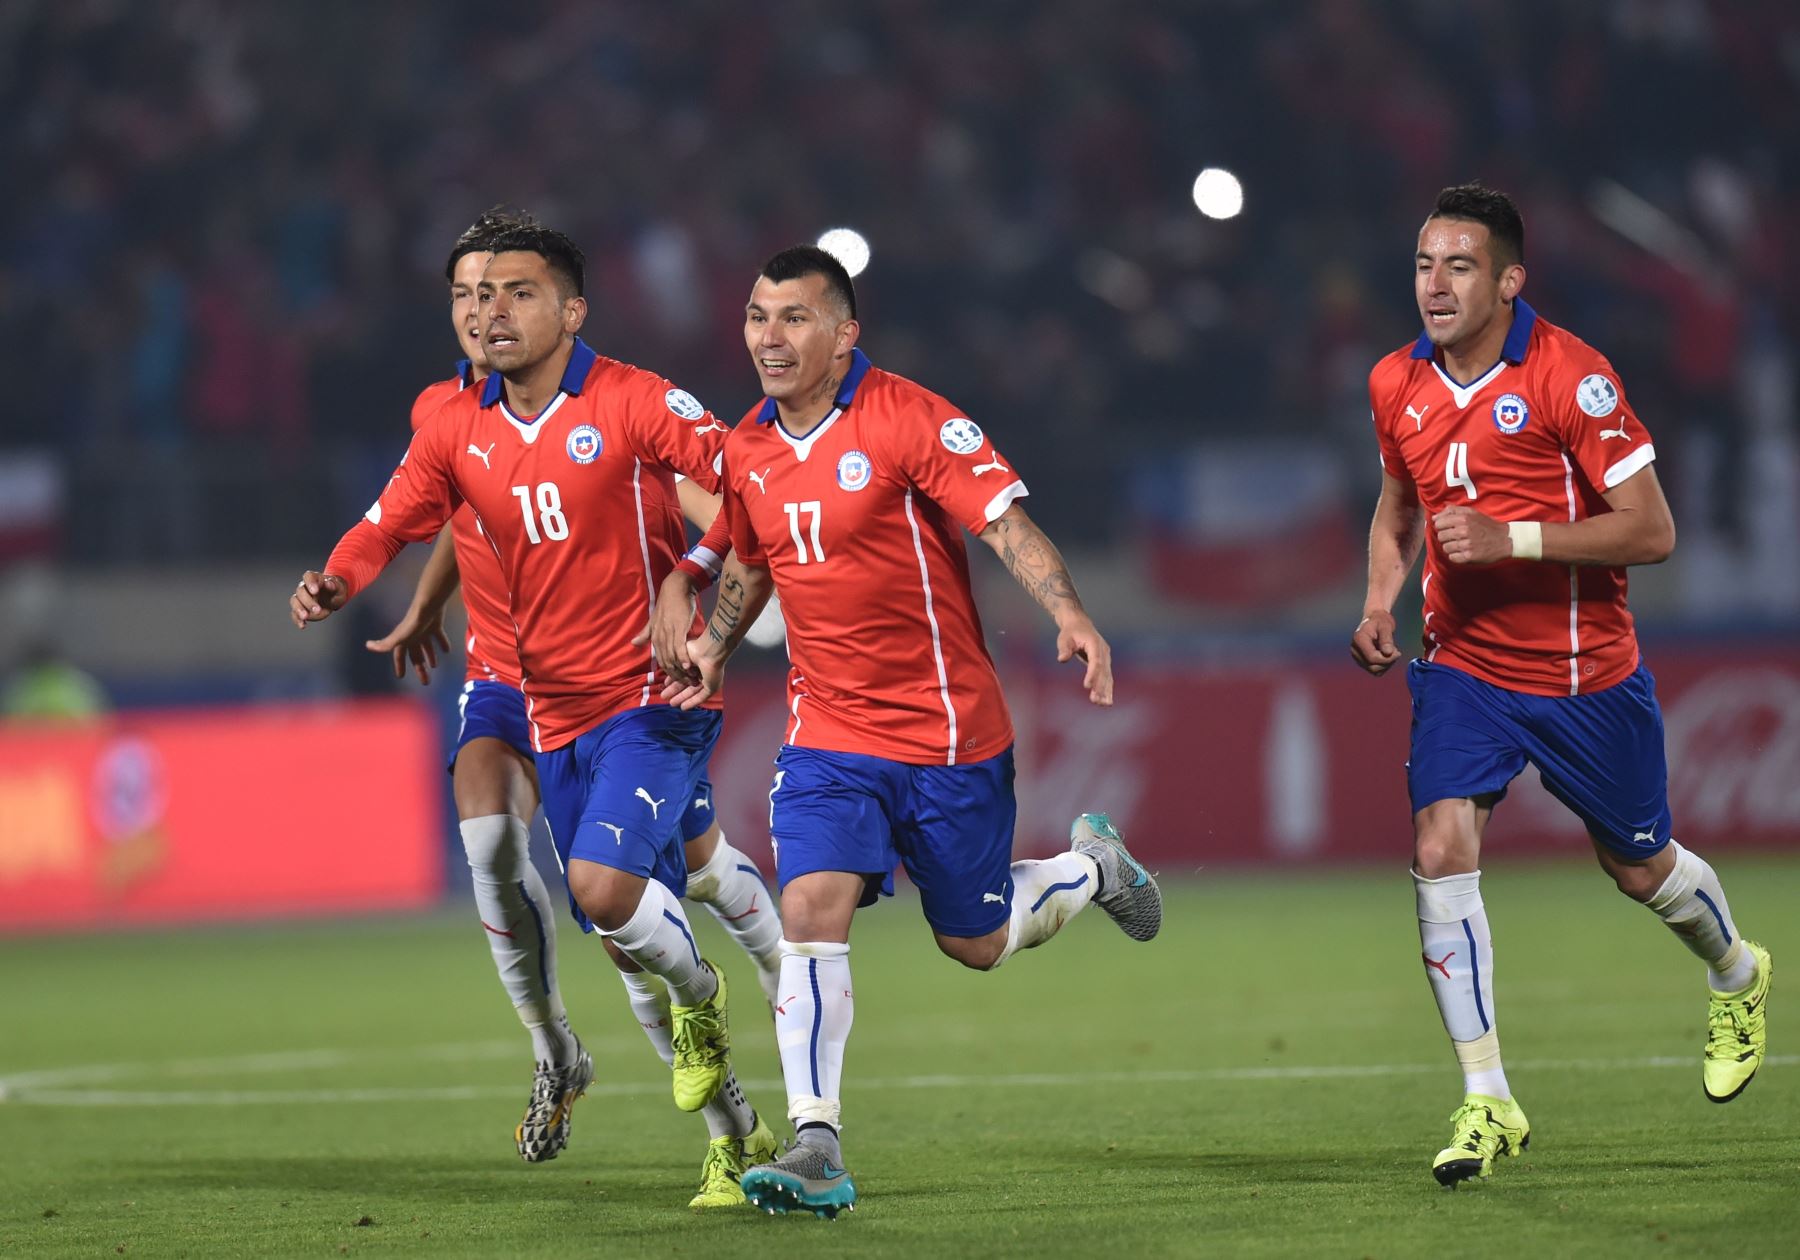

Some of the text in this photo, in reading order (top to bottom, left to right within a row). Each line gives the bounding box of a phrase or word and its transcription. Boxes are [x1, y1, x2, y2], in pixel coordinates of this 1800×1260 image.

[1446, 442, 1477, 500] 4
[511, 481, 569, 544] 18
[783, 500, 826, 564] 17
